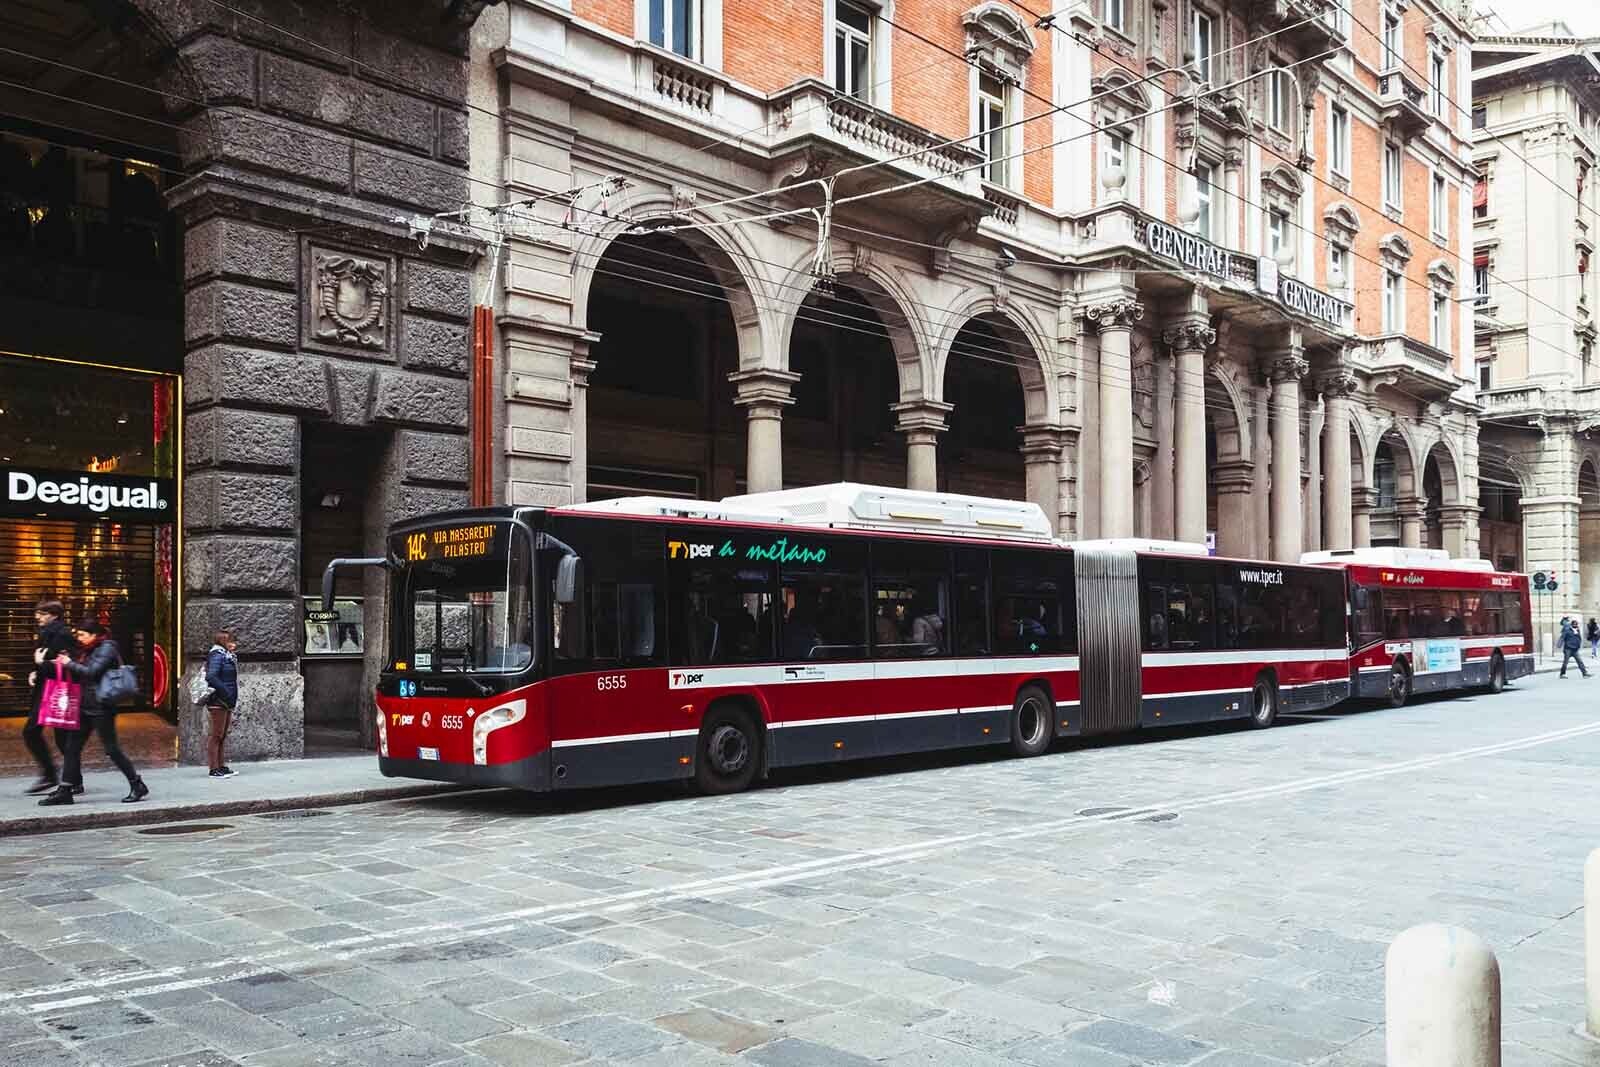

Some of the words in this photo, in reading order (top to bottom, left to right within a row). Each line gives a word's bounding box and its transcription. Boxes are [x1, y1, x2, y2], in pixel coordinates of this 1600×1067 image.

[1147, 222, 1232, 280] GENERALI
[1282, 279, 1344, 326] GENERALI
[434, 530, 447, 544] VIA
[449, 524, 497, 542] MASSARENT
[407, 533, 427, 561] 14C
[444, 541, 485, 558] PILASTRO
[718, 539, 737, 557] a
[745, 536, 827, 563] metano
[1239, 569, 1284, 588] www.tper.it
[597, 674, 627, 691] 6555
[441, 714, 463, 729] 6555
